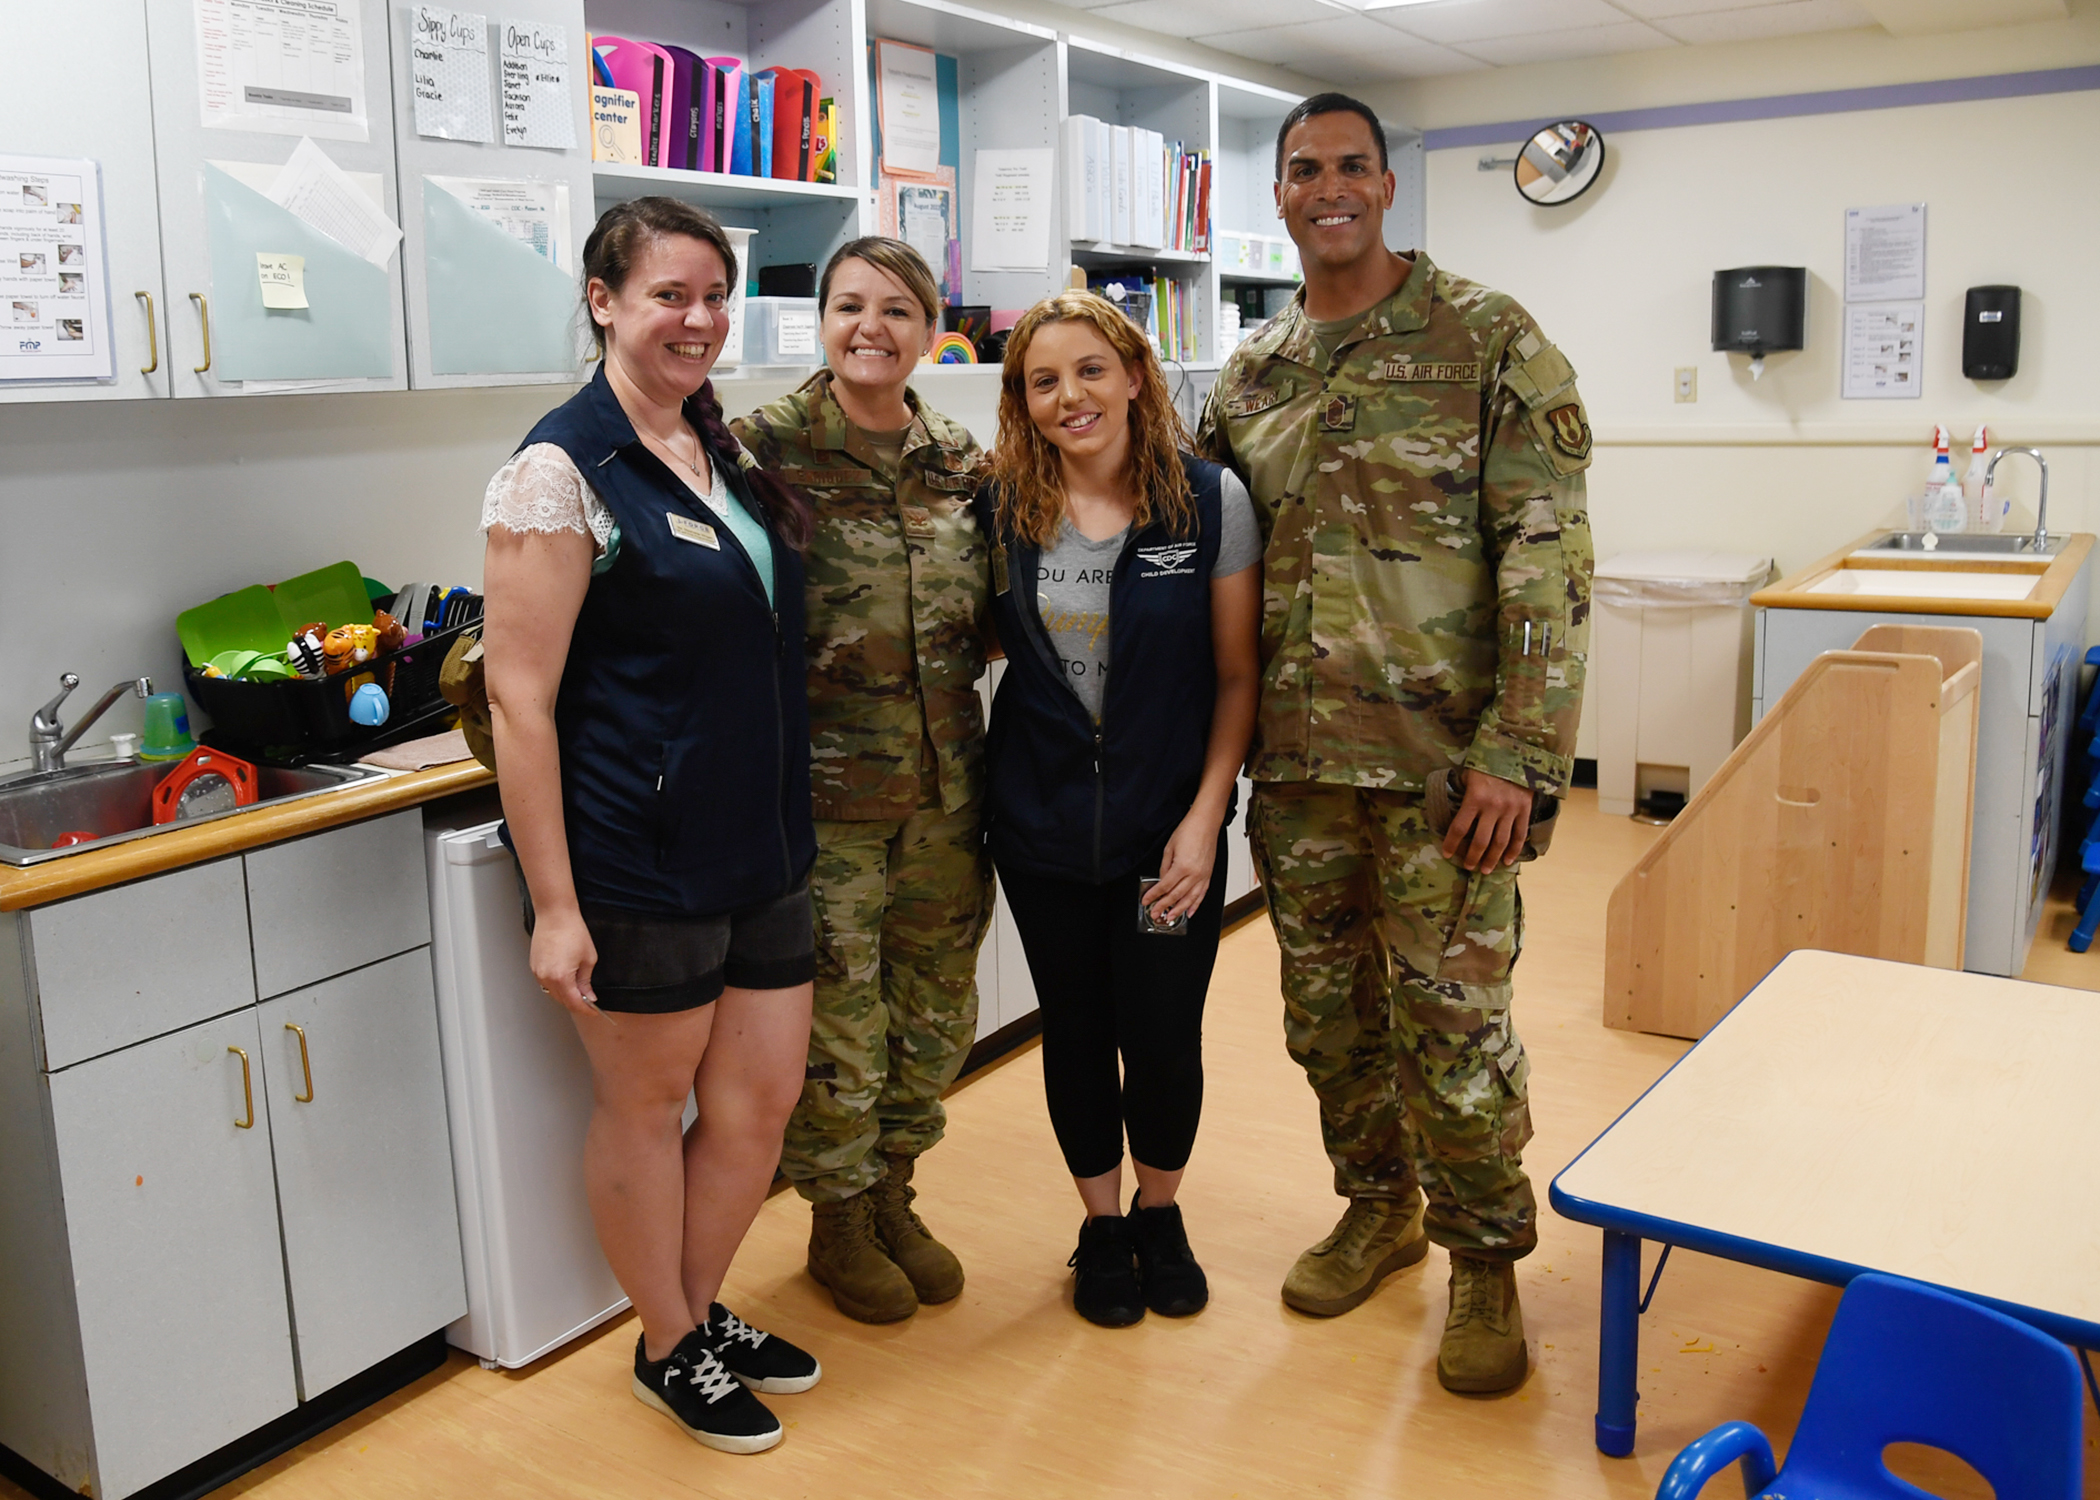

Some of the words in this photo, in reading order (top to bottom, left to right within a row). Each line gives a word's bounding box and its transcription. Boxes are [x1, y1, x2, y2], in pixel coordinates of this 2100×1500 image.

[307, 2, 334, 12] Schedule
[418, 7, 446, 43] Sippy
[450, 14, 475, 45] Cups
[507, 25, 530, 55] Open
[534, 31, 555, 56] Cups
[414, 48, 443, 62] Charlie
[416, 87, 444, 102] Gracie
[594, 93, 636, 109] agnifier
[594, 111, 628, 124] center
[0, 174, 28, 184] washing
[30, 176, 49, 184] Steps
[278, 262, 287, 270] AC
[1385, 364, 1407, 379] U.S.
[1411, 364, 1433, 379] AIR
[1437, 363, 1478, 379] FORCE
[1246, 388, 1280, 413] WEARY
[1162, 554, 1177, 562] CDC
[1036, 567, 1065, 583] OU
[1076, 568, 1112, 584] ARE
[1160, 568, 1196, 576] DEVELOPMENT
[1062, 659, 1086, 676] TO
[1097, 661, 1109, 677] M
